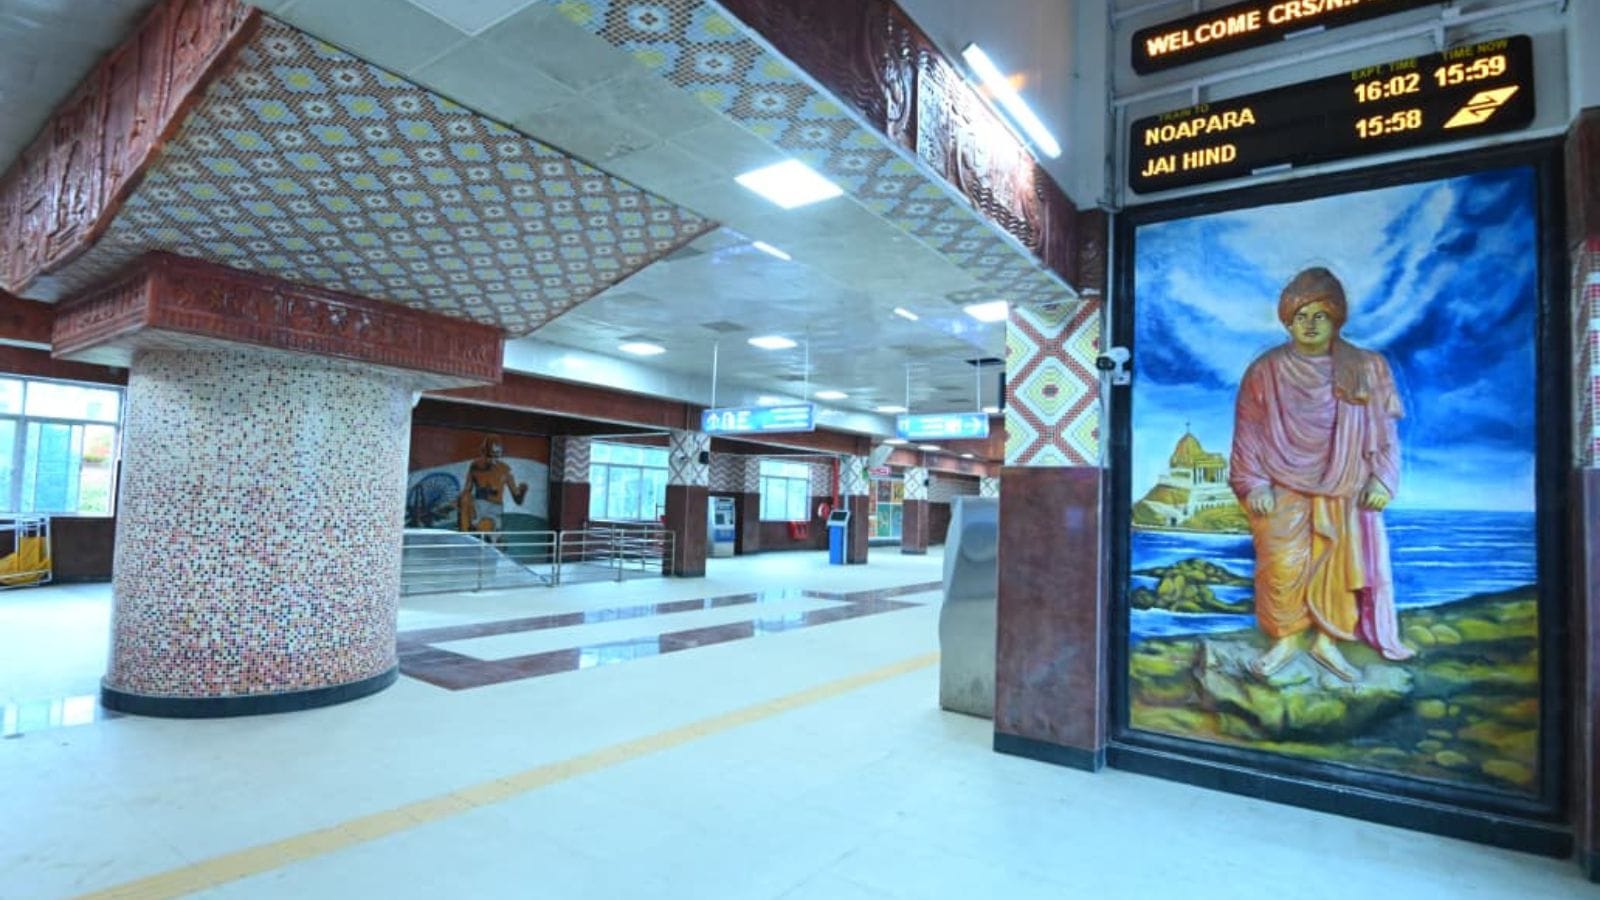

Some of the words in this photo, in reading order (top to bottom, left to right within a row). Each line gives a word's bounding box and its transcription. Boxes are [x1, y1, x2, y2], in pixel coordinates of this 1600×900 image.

[1147, 11, 1261, 56] WELCOME
[1478, 39, 1509, 53] NOW
[1389, 57, 1418, 71] TIME
[1434, 54, 1506, 87] 15:59
[1145, 107, 1256, 146] NOAPARA
[1354, 72, 1421, 103] 16:02
[1142, 154, 1177, 177] JAI
[1182, 144, 1237, 170] HIND
[1355, 108, 1422, 138] 15:58
